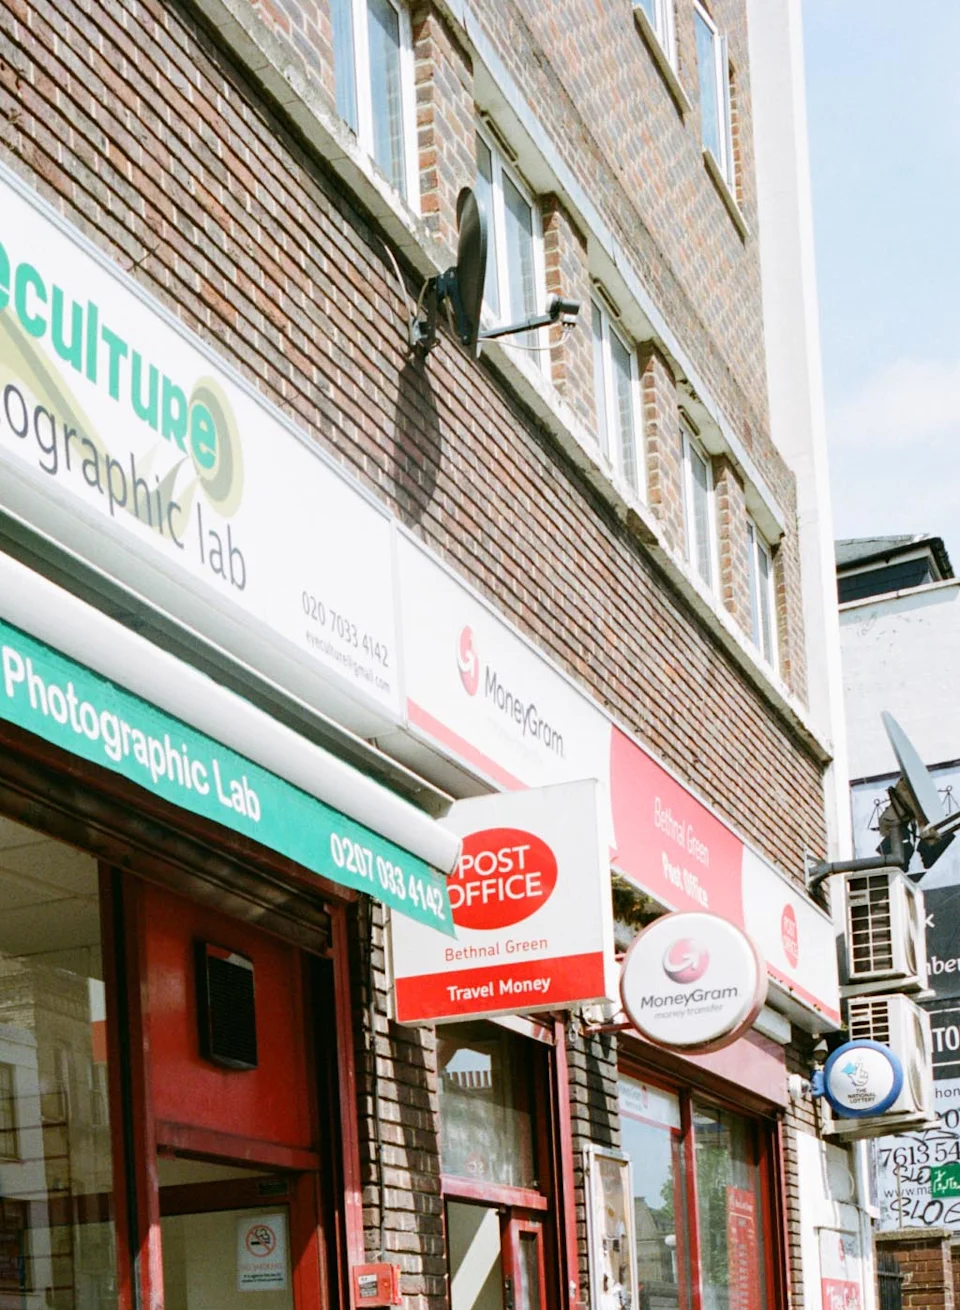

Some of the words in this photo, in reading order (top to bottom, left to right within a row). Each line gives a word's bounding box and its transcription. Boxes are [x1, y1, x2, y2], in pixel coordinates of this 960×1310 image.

[196, 502, 247, 592] lab
[302, 590, 326, 626] 020
[329, 609, 359, 648] 7033
[362, 633, 389, 668] 4142
[1, 645, 210, 796] Photographic
[212, 759, 262, 823] Lab
[485, 664, 564, 758] MoneyGram
[654, 796, 686, 848] Bethnal
[687, 824, 709, 870] Green
[330, 832, 374, 882] 0207
[377, 857, 406, 901] 033
[408, 873, 446, 921] 4142
[459, 845, 530, 880] POST
[661, 851, 684, 892] Post
[683, 869, 709, 909] Office
[446, 871, 543, 910] OFFICE
[445, 942, 499, 962] Bethnal
[505, 938, 549, 954] Green
[447, 982, 494, 1002] Travel
[499, 977, 551, 996] Money
[640, 985, 739, 1010] MoneyGram
[654, 1008, 685, 1020] money
[687, 1003, 724, 1015] transfer
[880, 1144, 930, 1167] 7613
